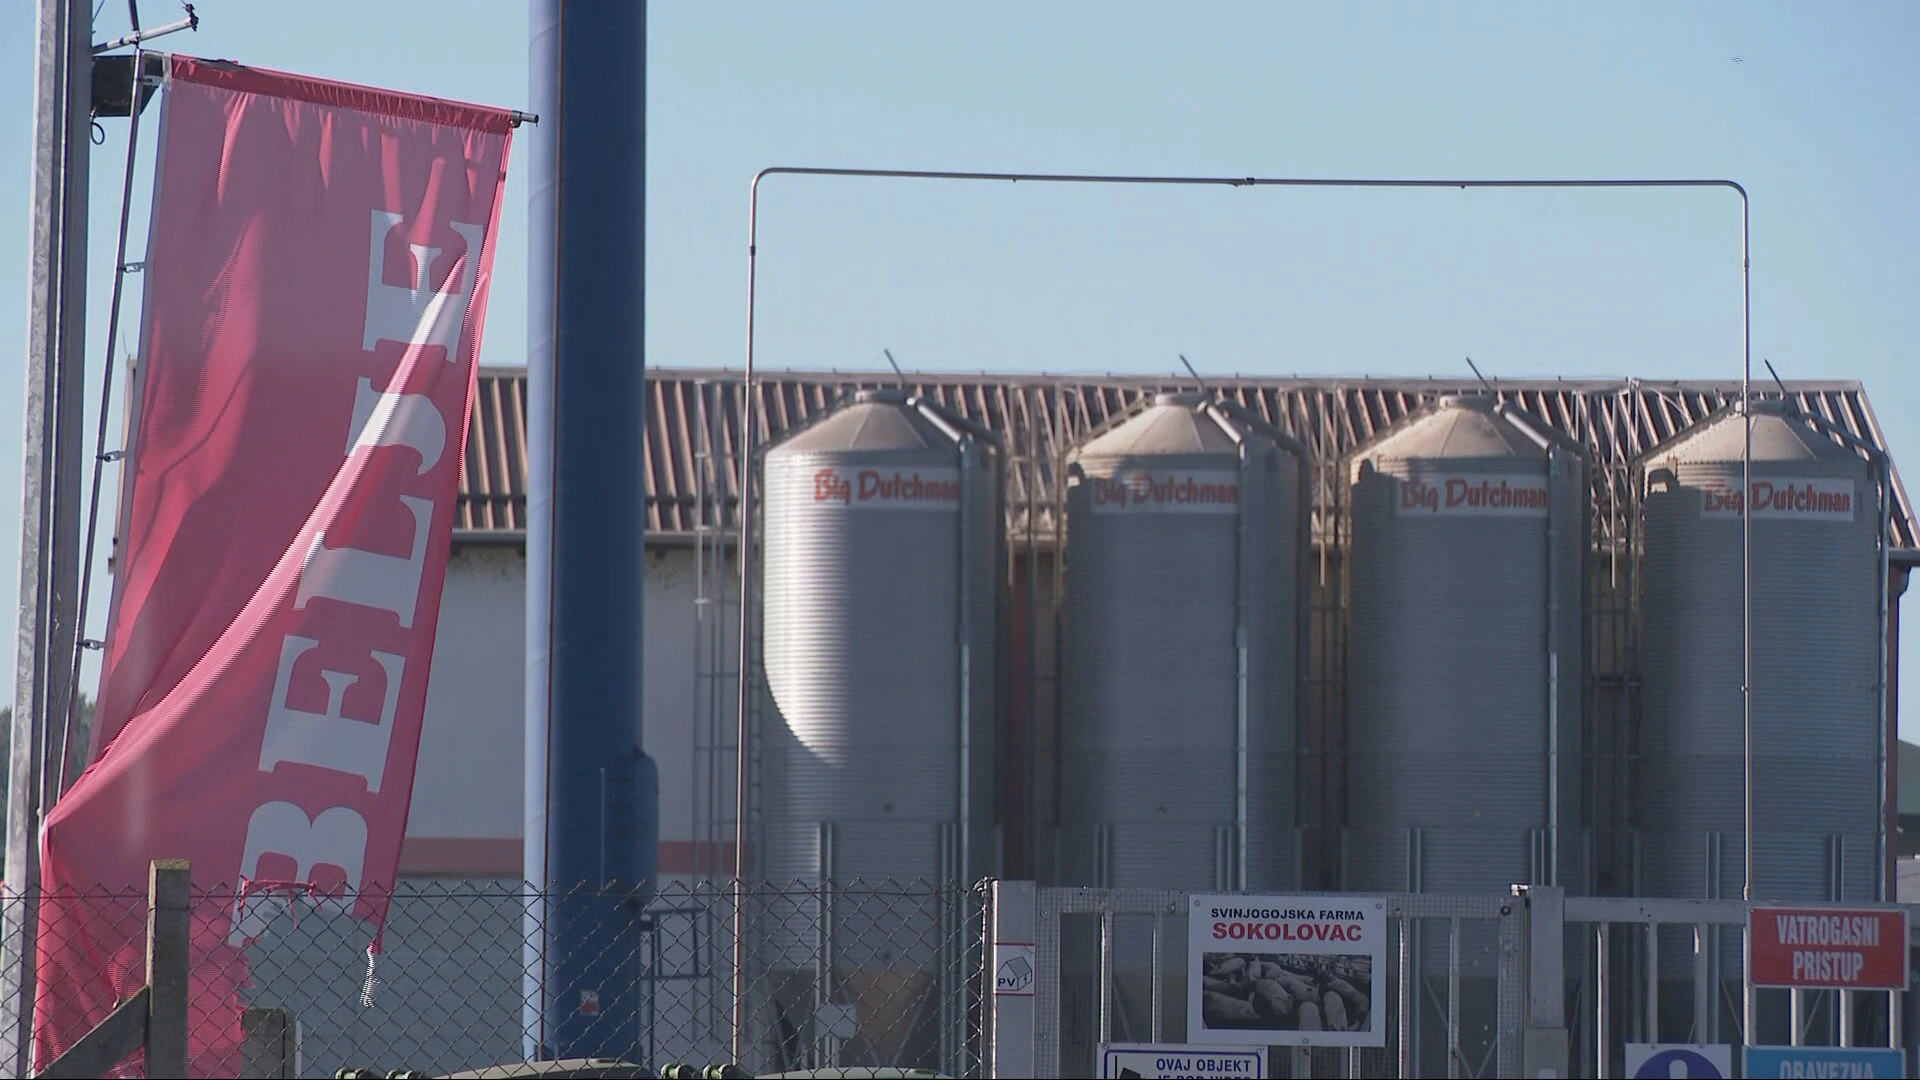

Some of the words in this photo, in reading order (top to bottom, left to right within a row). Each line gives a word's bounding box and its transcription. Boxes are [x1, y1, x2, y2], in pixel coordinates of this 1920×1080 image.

[814, 468, 852, 505] Big
[858, 470, 959, 501] Dutchman
[1133, 472, 1240, 505] Dutchman
[1401, 477, 1438, 513] Big
[1445, 477, 1547, 508] Dutchman
[1751, 482, 1851, 513] Dutchman
[228, 208, 484, 948] BELJE
[1211, 908, 1315, 919] SVINJOGOJSKA
[1319, 910, 1364, 920] FARMA
[1212, 922, 1362, 941] SOKOLOVAC
[1776, 915, 1880, 946] VATROGASNI
[1793, 950, 1864, 982] PRISTUP
[998, 978, 1016, 987] PV
[1156, 1058, 1191, 1071] OVAJ
[1196, 1059, 1251, 1072] OBJEKT
